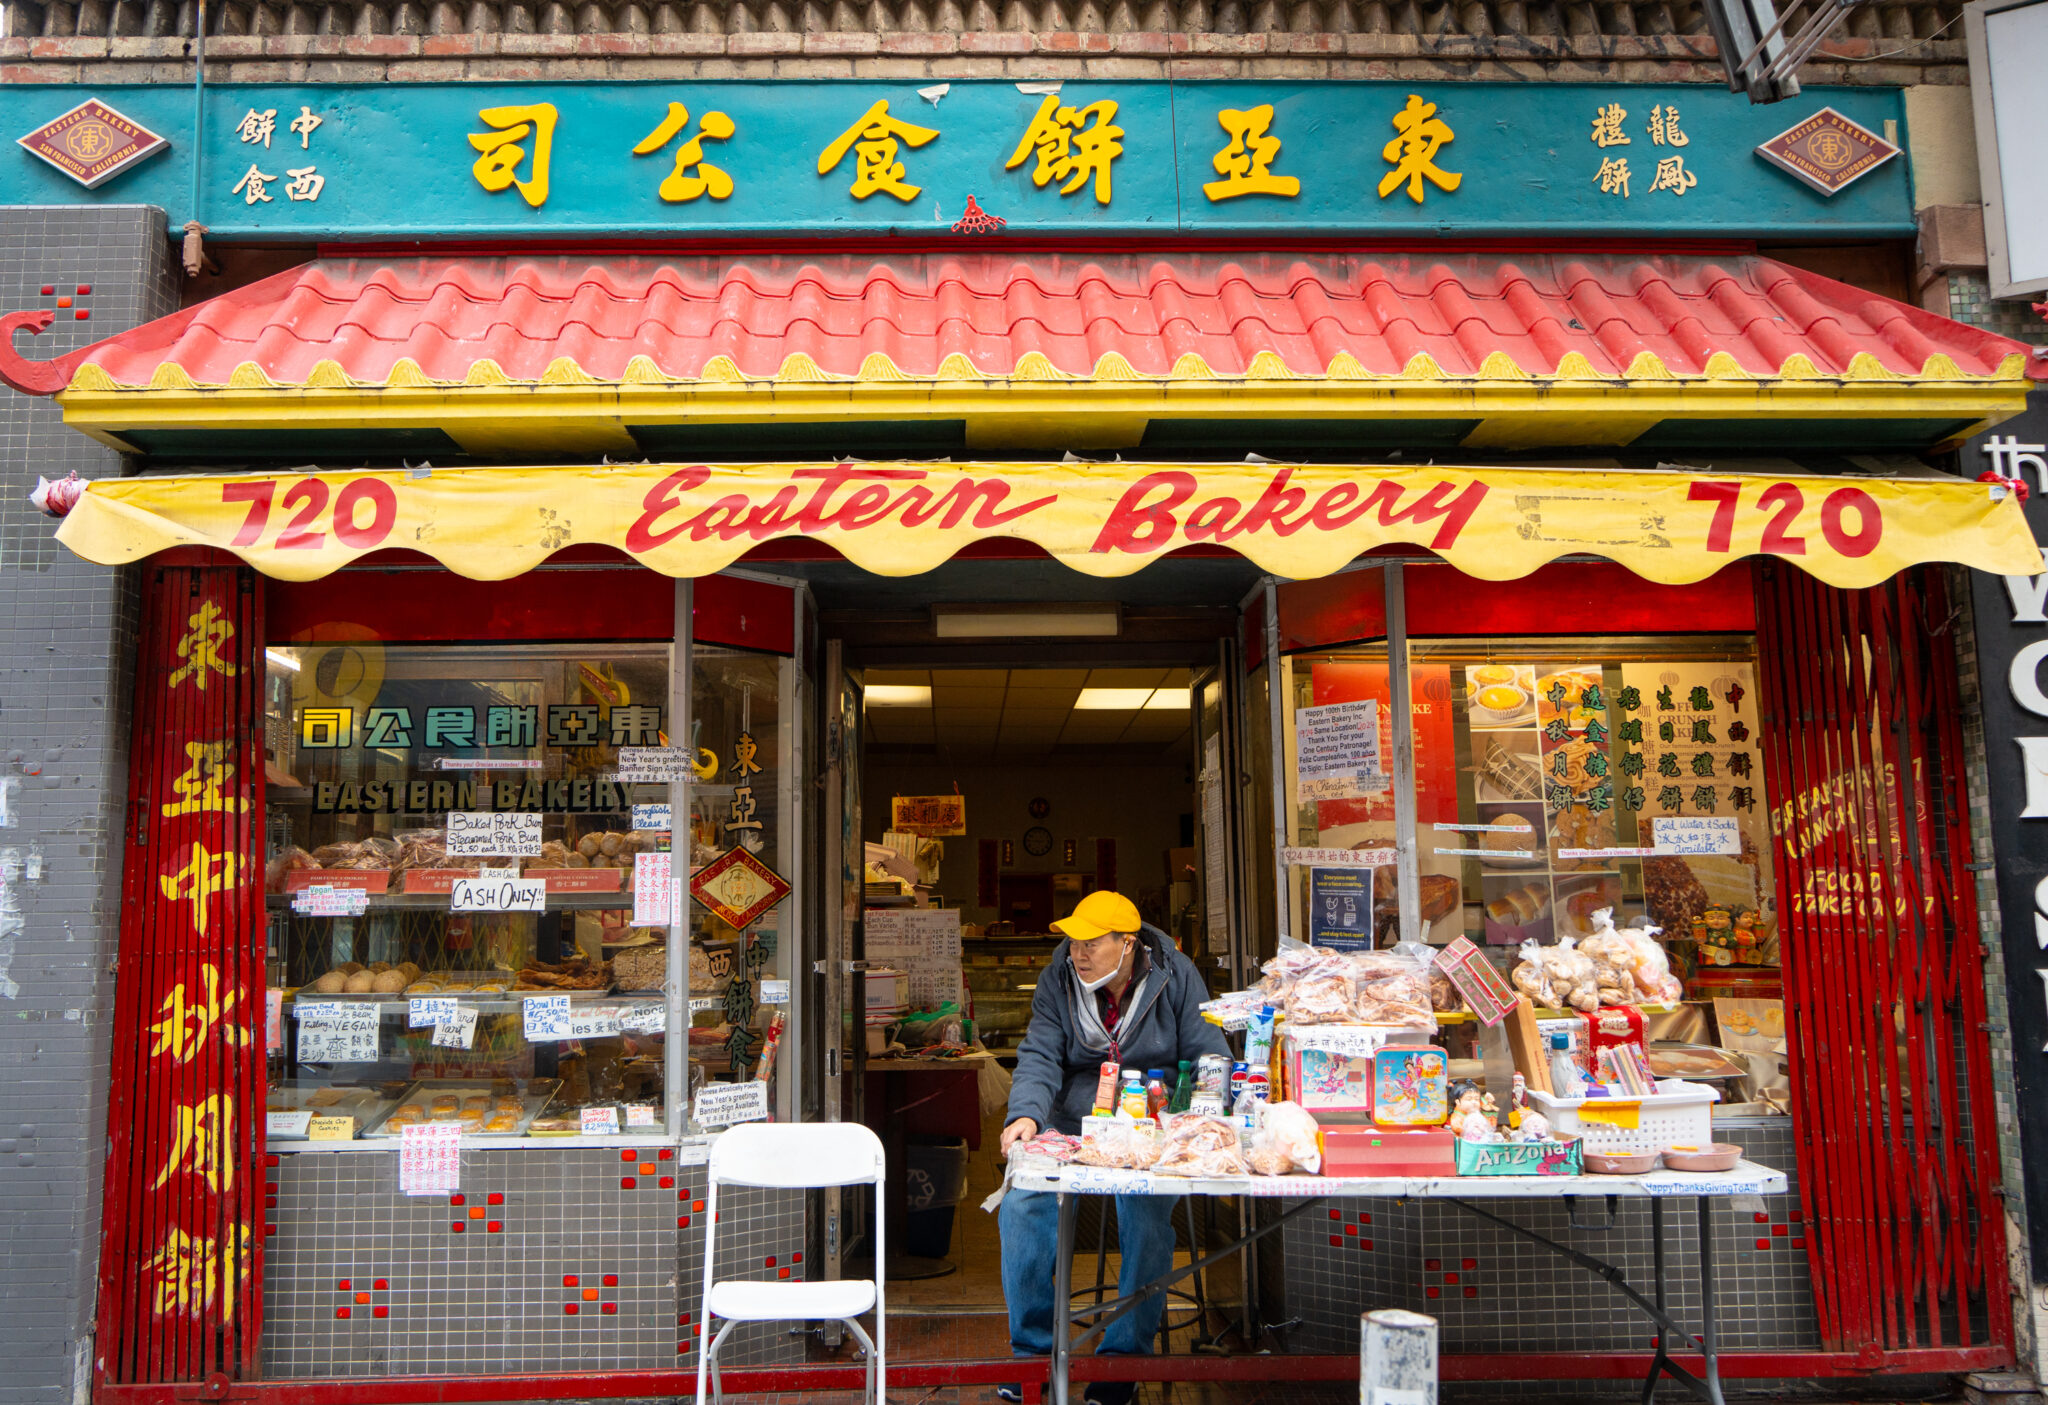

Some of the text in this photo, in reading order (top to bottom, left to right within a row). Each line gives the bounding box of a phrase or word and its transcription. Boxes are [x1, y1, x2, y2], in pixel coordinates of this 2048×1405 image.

[43, 108, 141, 138] EASTERN BAKERY
[1785, 117, 1876, 147] EASTERN BAKERY
[81, 128, 98, 154] 東
[1822, 136, 1838, 161] 東
[39, 143, 139, 176] SAN FRANCISCO CALIFORNIA
[1783, 149, 1878, 183] SAN FRANCISCO CALIFORNIA
[221, 463, 1884, 558] 720 Eastern Bakery 720
[1305, 709, 1324, 718] Happy
[1325, 706, 1340, 714] 100th
[1342, 704, 1367, 713] Birthday
[1309, 717, 1330, 726] Eastern
[1332, 715, 1351, 723] Bakery
[1308, 737, 1325, 745] Thank
[1351, 732, 1364, 741] your
[1314, 727, 1330, 735] Same
[639, 755, 660, 763] Year's
[1316, 744, 1338, 753] Century
[1340, 740, 1372, 750] Patronage!
[1545, 682, 1575, 813] 中秋月餅
[1656, 685, 1684, 814] 生日花餅
[1688, 686, 1717, 814] 龍鳳禮餅
[647, 765, 662, 774] Sign
[1299, 755, 1312, 764] Feliz
[1324, 762, 1345, 770] Eastern
[1347, 760, 1367, 768] Bakery
[313, 780, 637, 813] EASTERN BAKERY
[699, 855, 777, 885] EASTERN BAKERY
[309, 886, 332, 895] Vegan
[452, 880, 496, 908] CASH
[700, 1100, 759, 1115] Banner Sign Available
[701, 1098, 713, 1106] New
